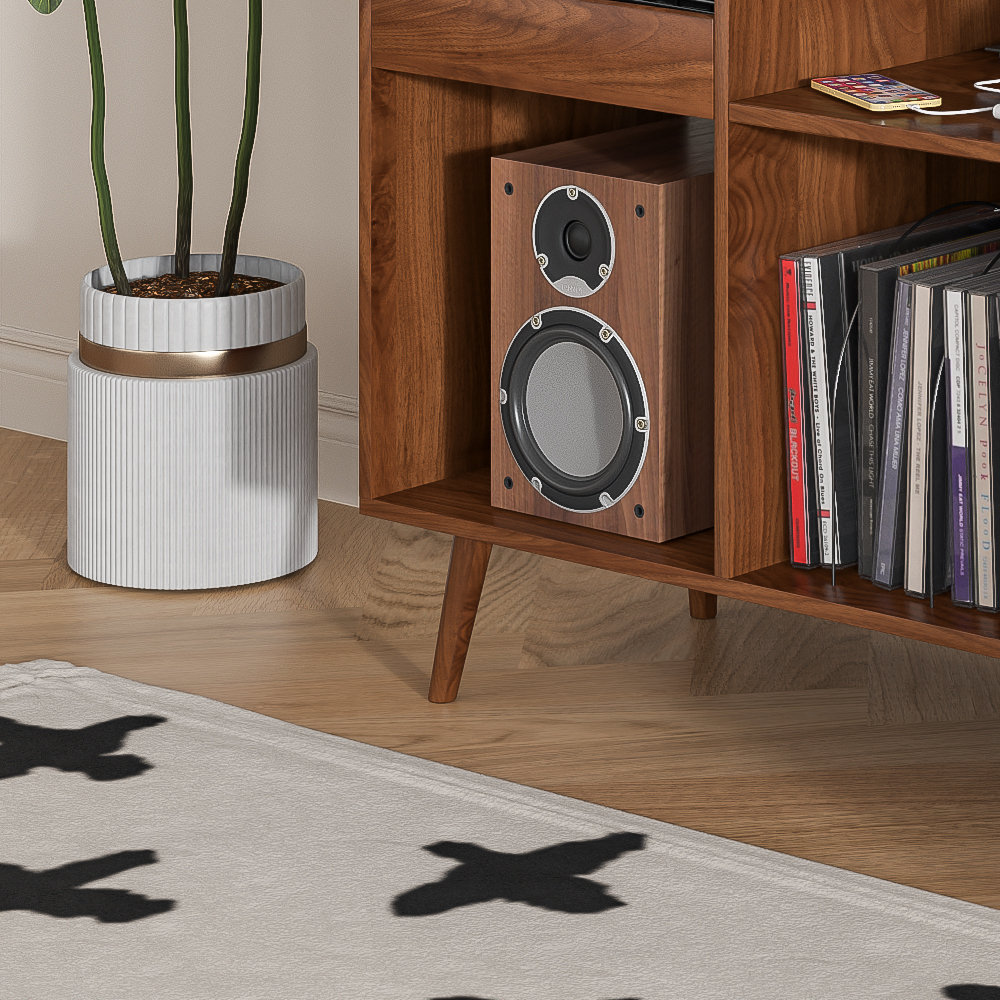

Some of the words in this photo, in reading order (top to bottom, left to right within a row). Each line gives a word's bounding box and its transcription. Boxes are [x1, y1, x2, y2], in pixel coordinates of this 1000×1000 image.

[901, 328, 909, 359] JENNIFER
[896, 387, 904, 411] COMO
[895, 412, 903, 430] AMA
[893, 430, 901, 446] UNA
[789, 428, 799, 482] BLACKOUT
[819, 473, 824, 484] On
